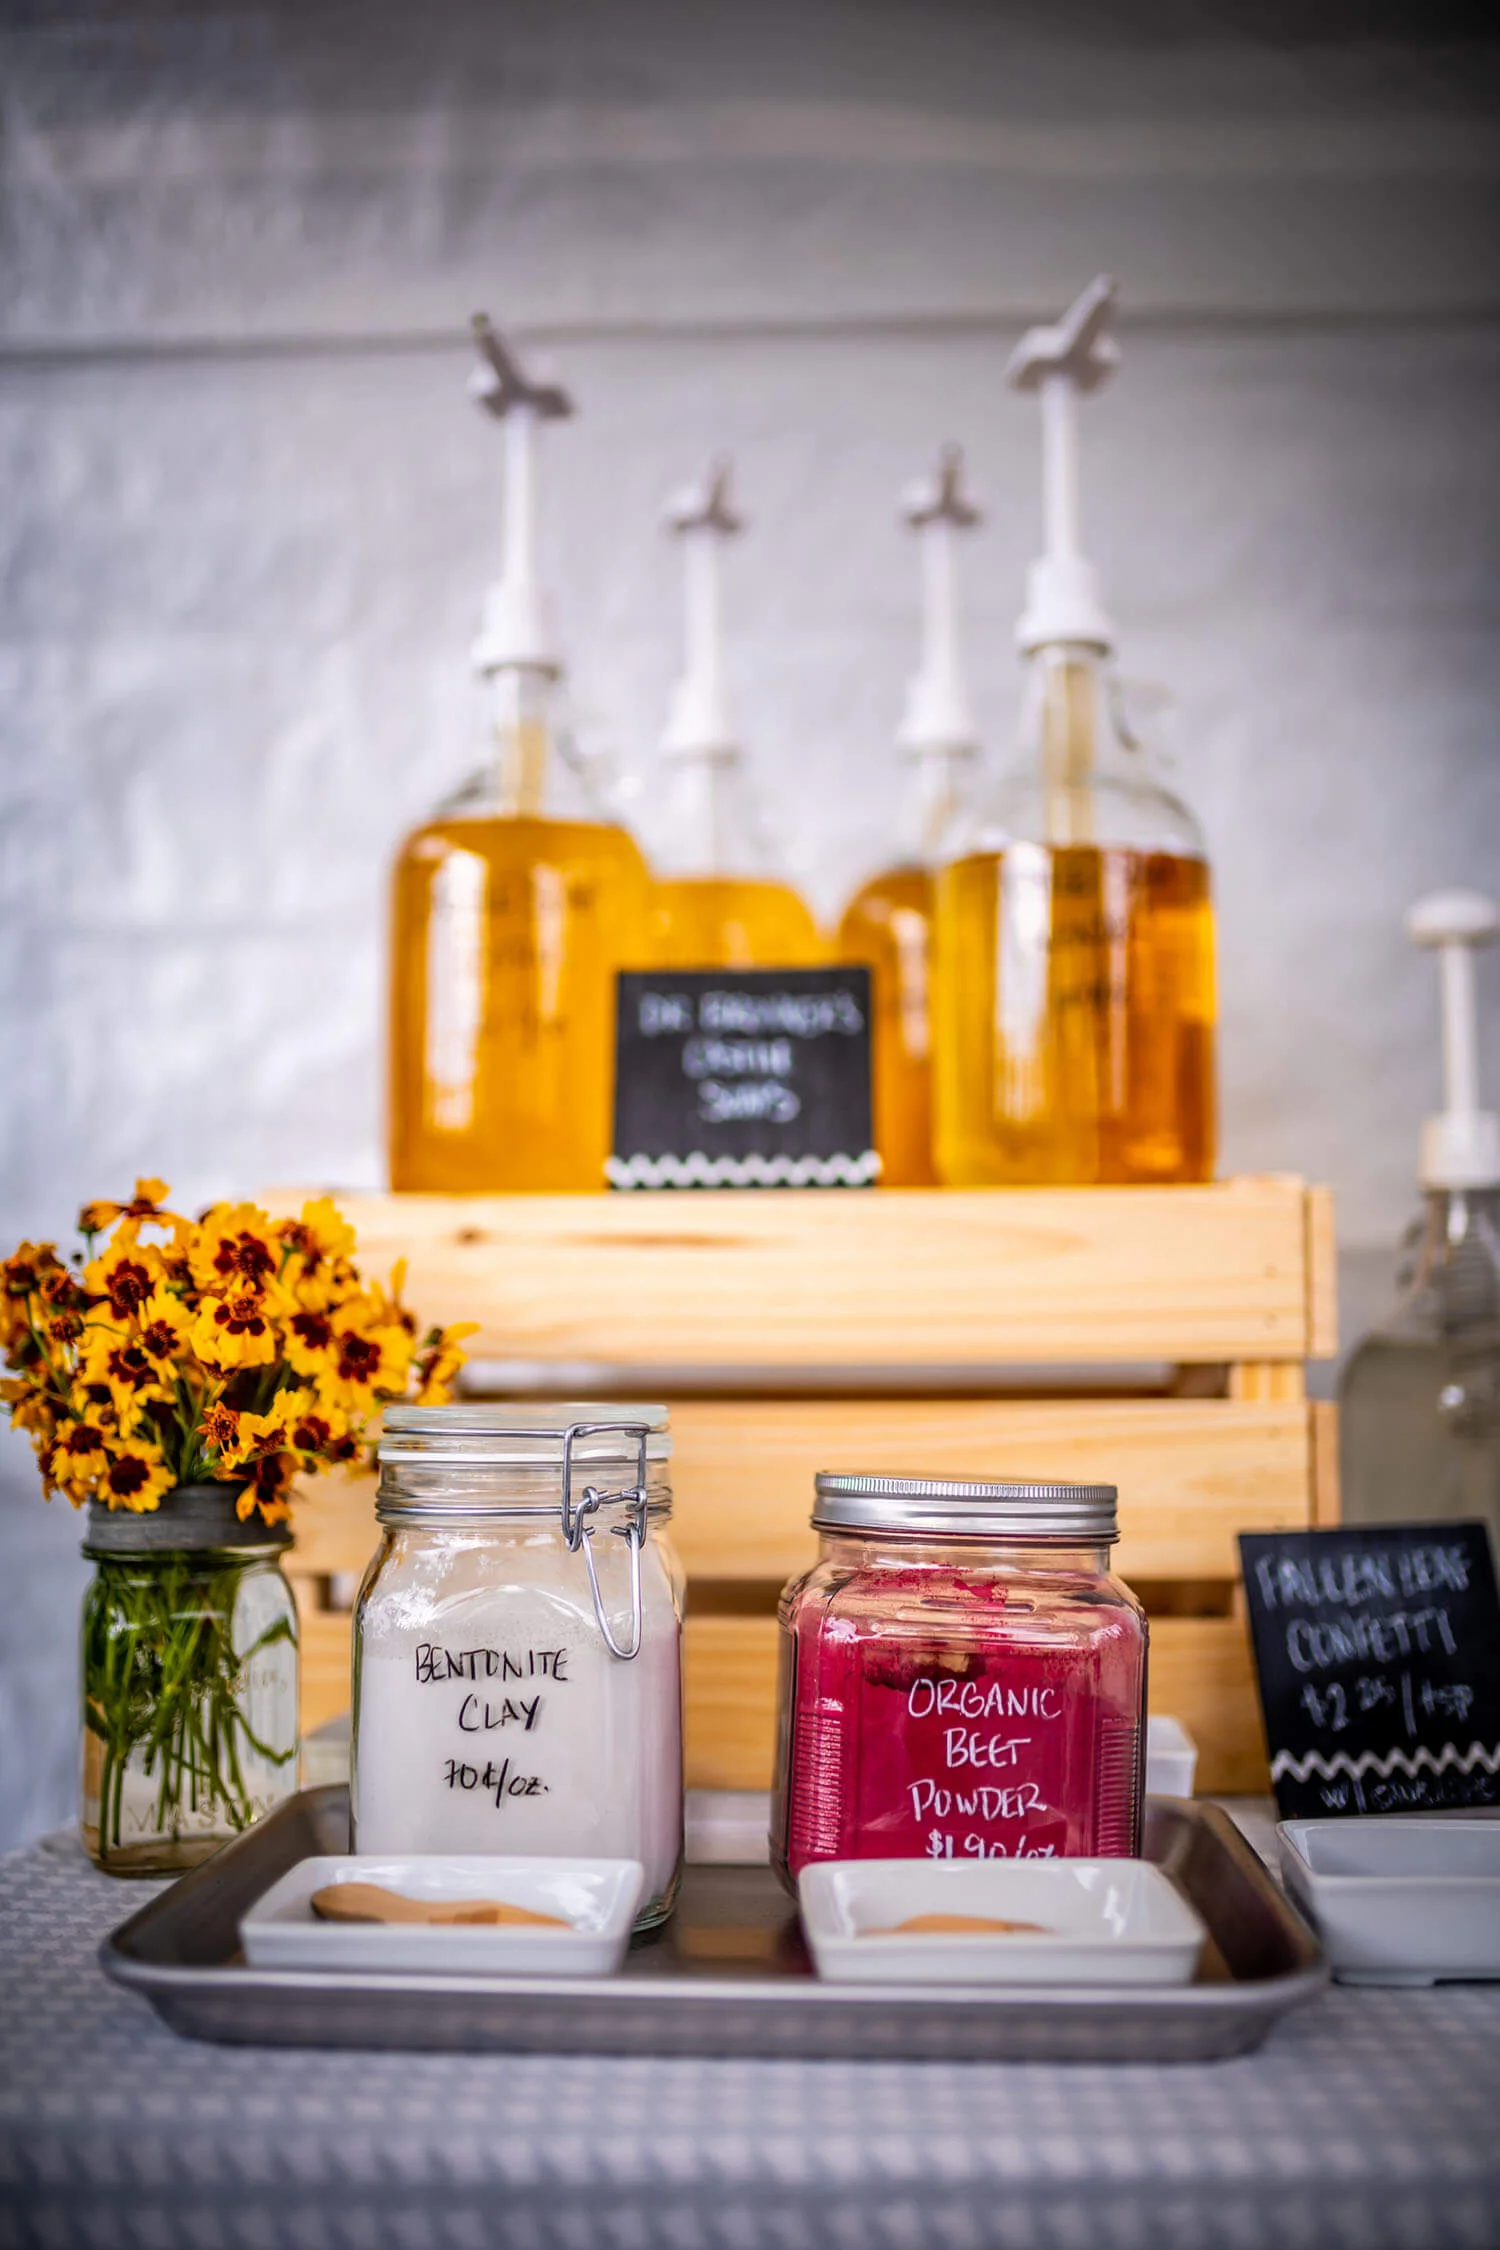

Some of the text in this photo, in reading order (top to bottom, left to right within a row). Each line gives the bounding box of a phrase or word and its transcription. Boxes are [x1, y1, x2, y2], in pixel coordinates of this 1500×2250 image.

[1286, 1607, 1457, 1672] CONFETTI
[416, 1643, 568, 1683] BENTONITE
[458, 1693, 540, 1731] CLAY
[908, 1678, 1061, 1719] ORGANIC
[943, 1727, 1031, 1767] BEET
[907, 1779, 1047, 1821] POWDER
